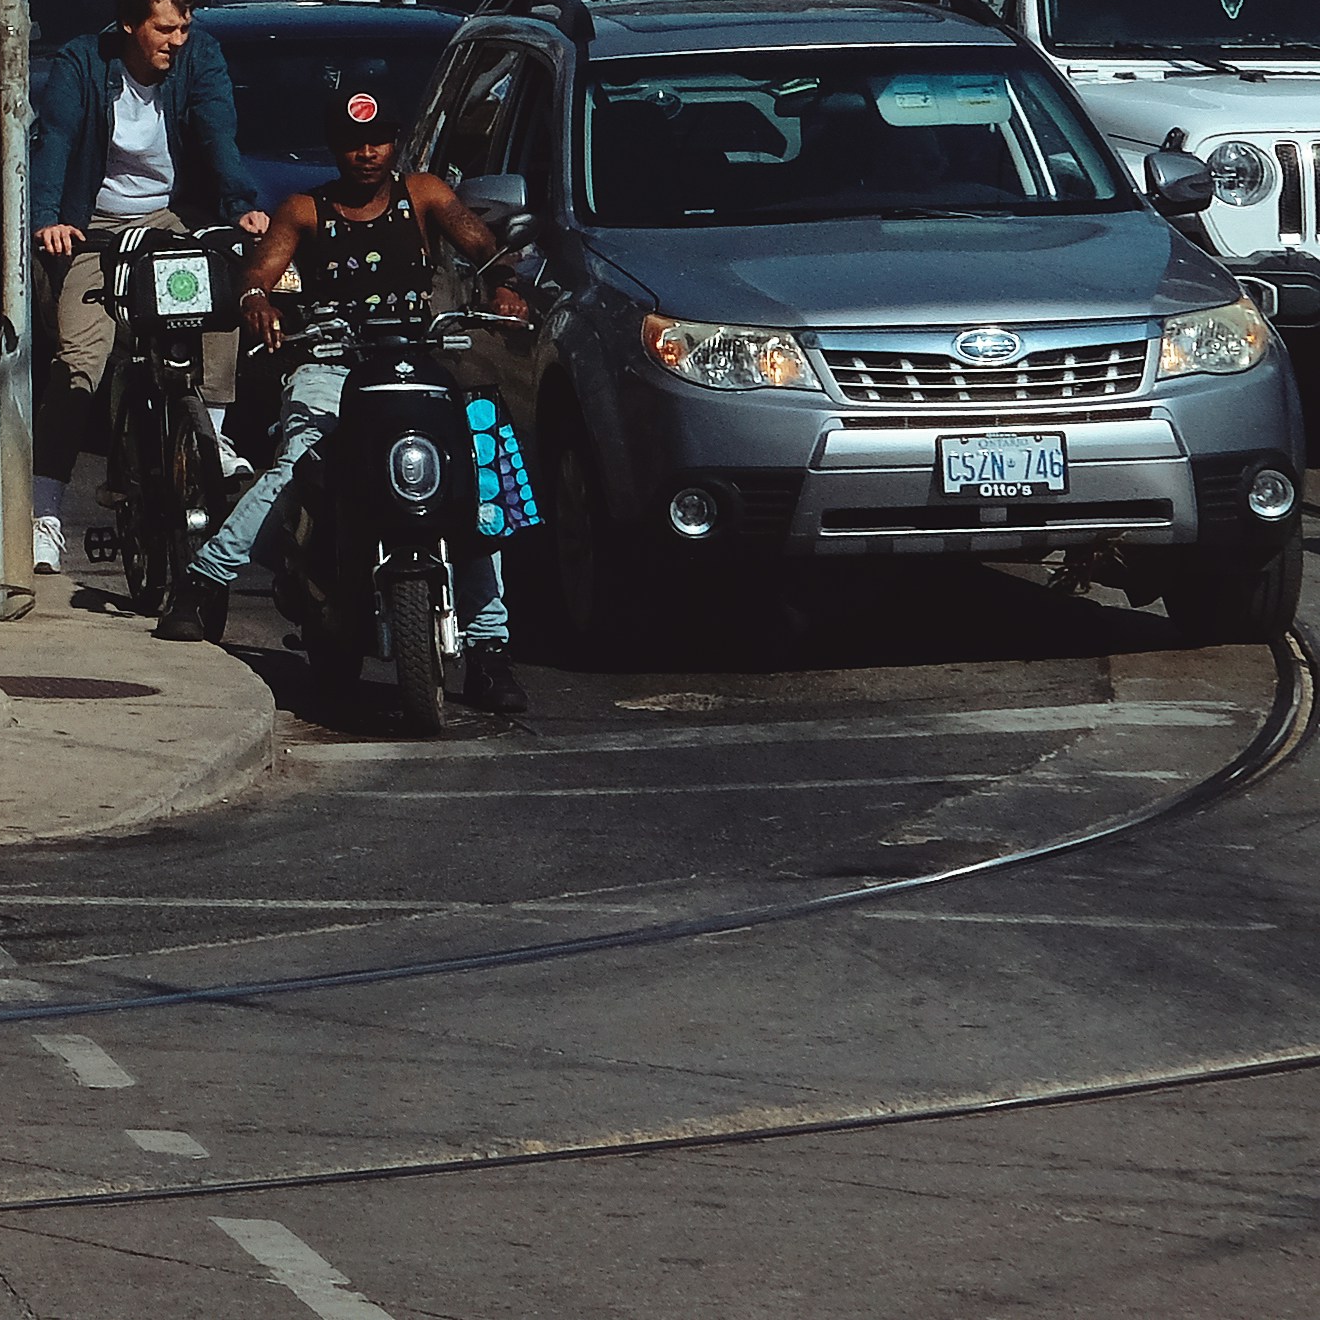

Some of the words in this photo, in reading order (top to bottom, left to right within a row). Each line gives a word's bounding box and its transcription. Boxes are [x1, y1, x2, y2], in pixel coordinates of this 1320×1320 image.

[978, 439, 1029, 448] ONTARIO
[1023, 447, 1064, 480] 746
[979, 482, 1033, 497] Otto's
